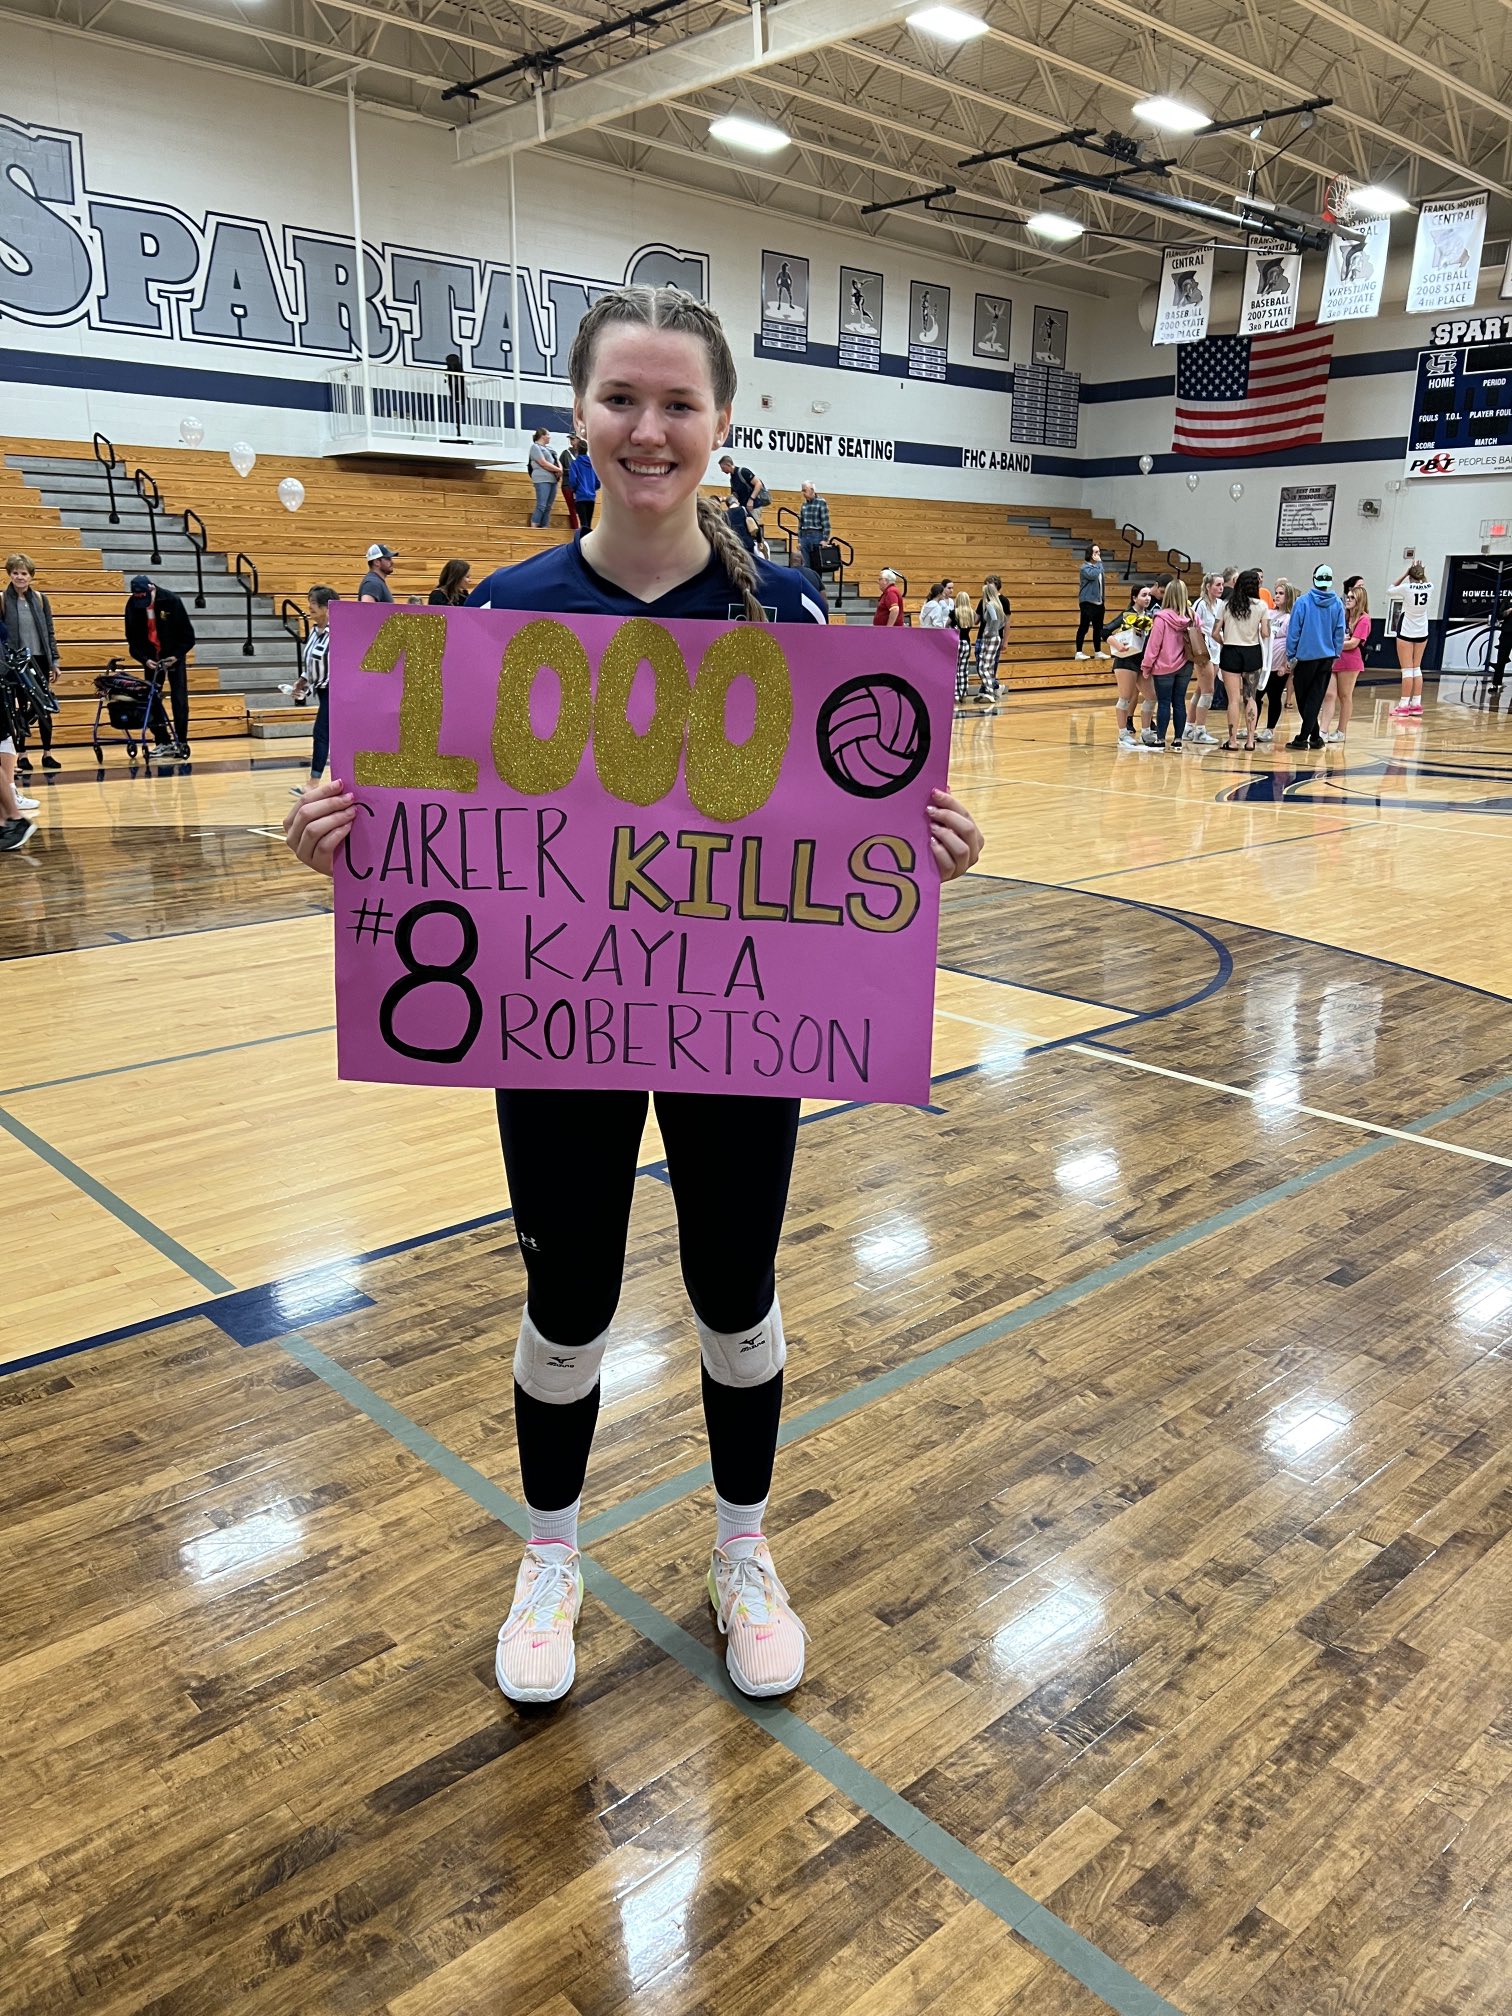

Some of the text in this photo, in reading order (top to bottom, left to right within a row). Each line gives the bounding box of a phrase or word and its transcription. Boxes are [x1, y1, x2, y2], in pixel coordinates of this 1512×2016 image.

[1423, 197, 1486, 214] FRANCIS HOWELL
[1432, 211, 1475, 225] CENTRAL
[1172, 254, 1205, 270] CENTRAL
[1423, 270, 1468, 283] SOFTBALL
[1329, 281, 1377, 297] WRESTLING
[1416, 281, 1472, 296] 2008 STATE
[1251, 296, 1289, 309] BASEBALL
[1327, 293, 1374, 308] 2007 STATE
[1438, 293, 1466, 305] PLACE
[1247, 306, 1291, 321] 2007 STATE
[1343, 304, 1369, 316] PLACE
[1181, 318, 1204, 327] STATE
[1249, 318, 1288, 332] 3RD PLACE
[1177, 328, 1201, 339] PLACE
[1428, 377, 1456, 389] HOME
[1483, 378, 1507, 387] PERIOD
[1419, 414, 1439, 422] FOULS
[1469, 410, 1494, 419] PLAYER
[734, 426, 893, 461] FHC STUDENT SEATING
[1415, 442, 1435, 450] SCORE
[1474, 438, 1498, 446] MATCH
[963, 448, 1031, 473] FHC A-BAND
[1458, 456, 1497, 466] PEOPLES
[1414, 592, 1428, 606] 13
[354, 612, 793, 823] 1000
[344, 801, 921, 932] CAREER KILLS
[346, 897, 765, 1064] #8 KAYLA
[500, 994, 871, 1083] ROBERTSON
